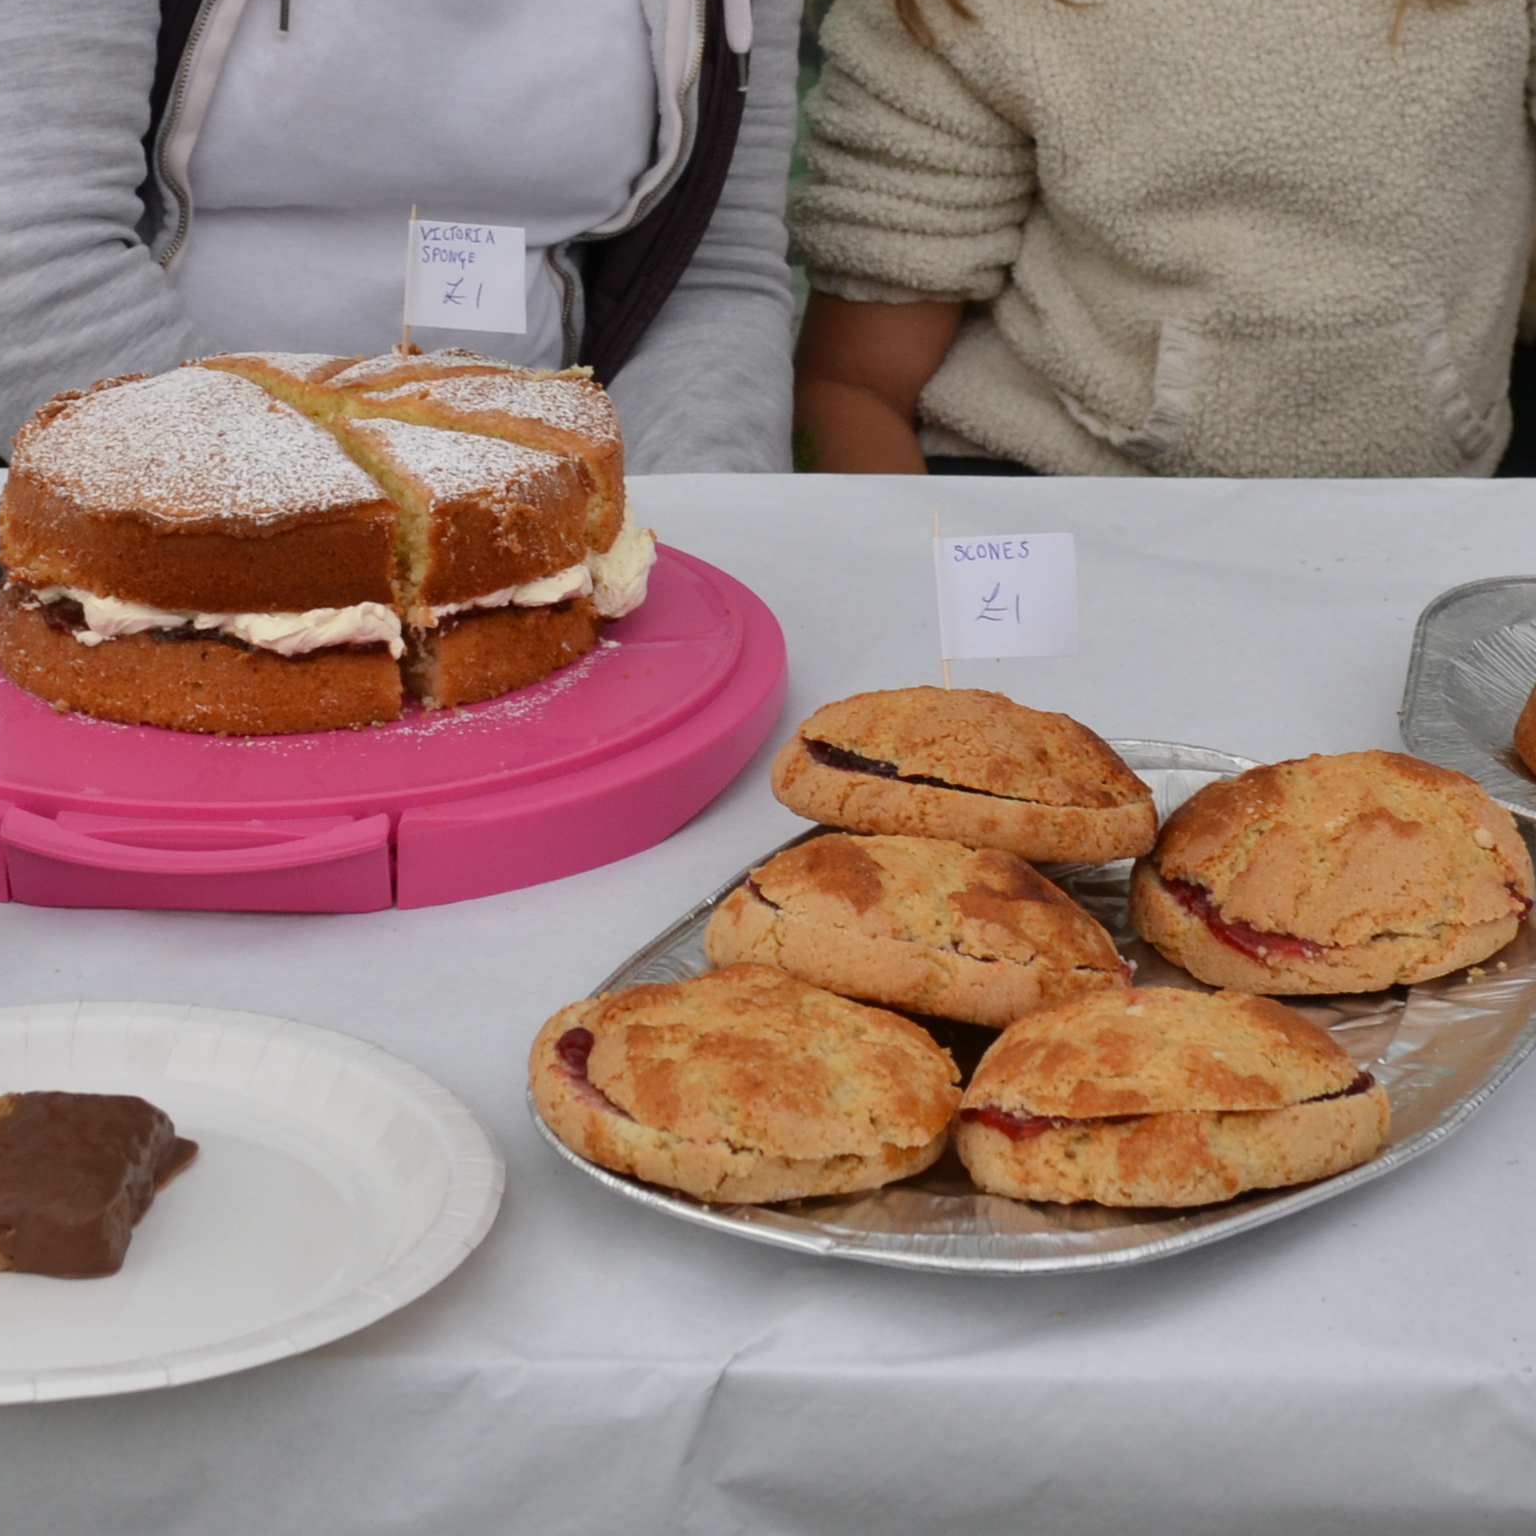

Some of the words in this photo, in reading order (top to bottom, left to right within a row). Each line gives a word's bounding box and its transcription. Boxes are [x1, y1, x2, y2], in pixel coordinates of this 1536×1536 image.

[420, 225, 495, 245] VICTORIA
[421, 245, 476, 270] SPONGE
[442, 277, 483, 309] £1
[953, 540, 1030, 562] SCONES
[975, 582, 1021, 625] £1
